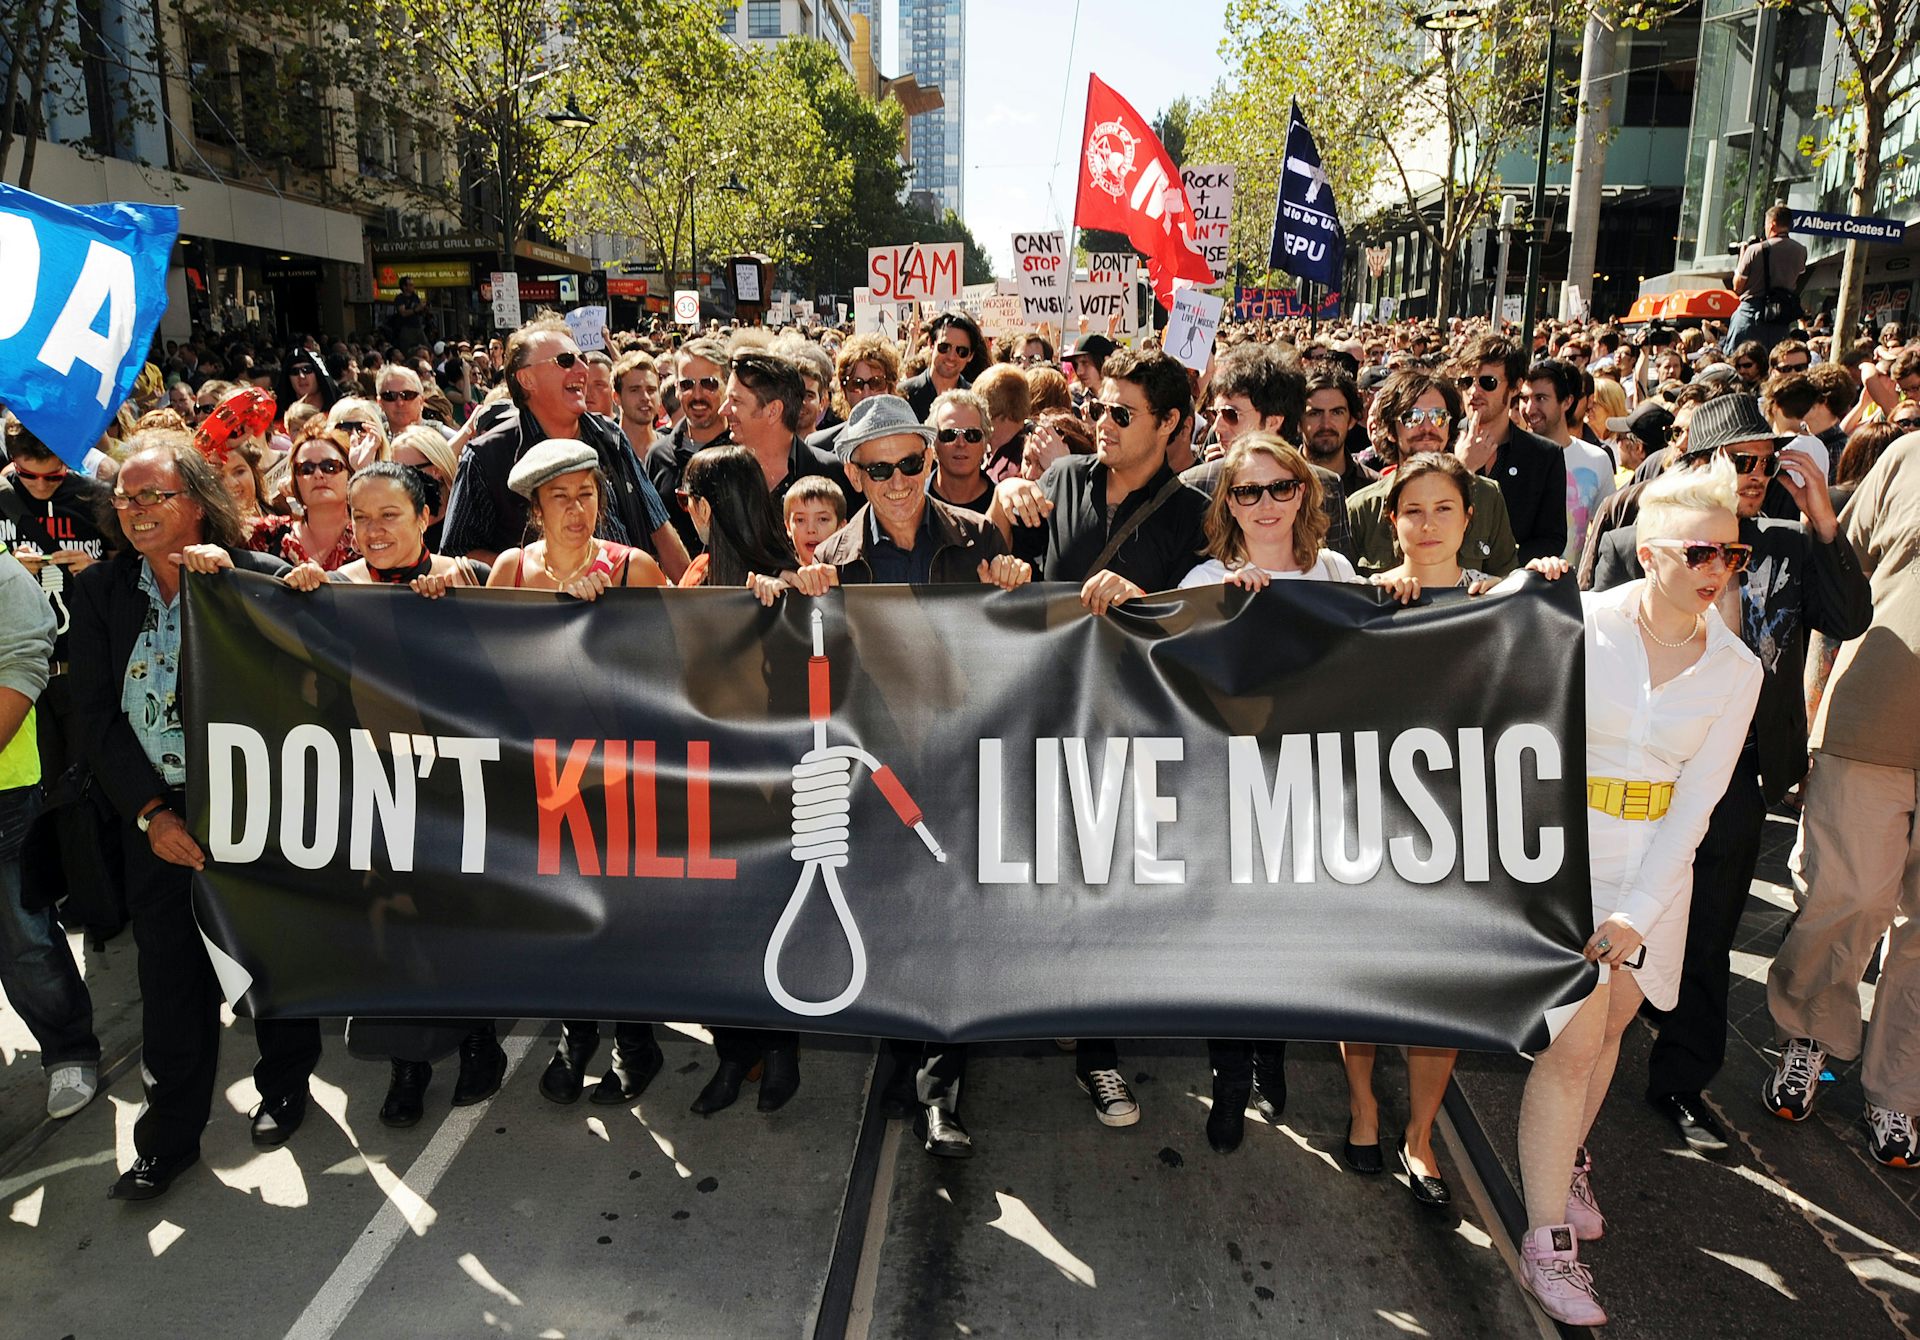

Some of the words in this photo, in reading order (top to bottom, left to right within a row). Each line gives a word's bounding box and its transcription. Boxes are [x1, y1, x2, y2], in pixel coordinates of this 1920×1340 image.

[1181, 170, 1230, 189] ROCK
[1193, 205, 1227, 221] OLL
[1302, 211, 1318, 226] be
[1191, 222, 1229, 241] IN'T
[1802, 215, 1842, 232] Albert
[1843, 220, 1884, 237] Coates
[1885, 224, 1901, 238] Ln
[443, 238, 471, 249] GRILL
[1014, 232, 1063, 254] CAN'T
[1023, 255, 1060, 272] STOP
[871, 248, 957, 300] SLAM
[1031, 275, 1057, 287] THE
[680, 302, 695, 312] 30
[1080, 295, 1122, 316] VOTE
[1175, 300, 1192, 313] DON'T
[1181, 313, 1193, 324] LIVE
[1197, 317, 1215, 328] MUSIC
[576, 332, 600, 347] USIC
[59, 538, 103, 560] MUSIC
[207, 722, 500, 873] DON'T
[533, 738, 737, 879] KILL
[978, 736, 1186, 885] LIVE
[1228, 723, 1565, 885] MUSIC
